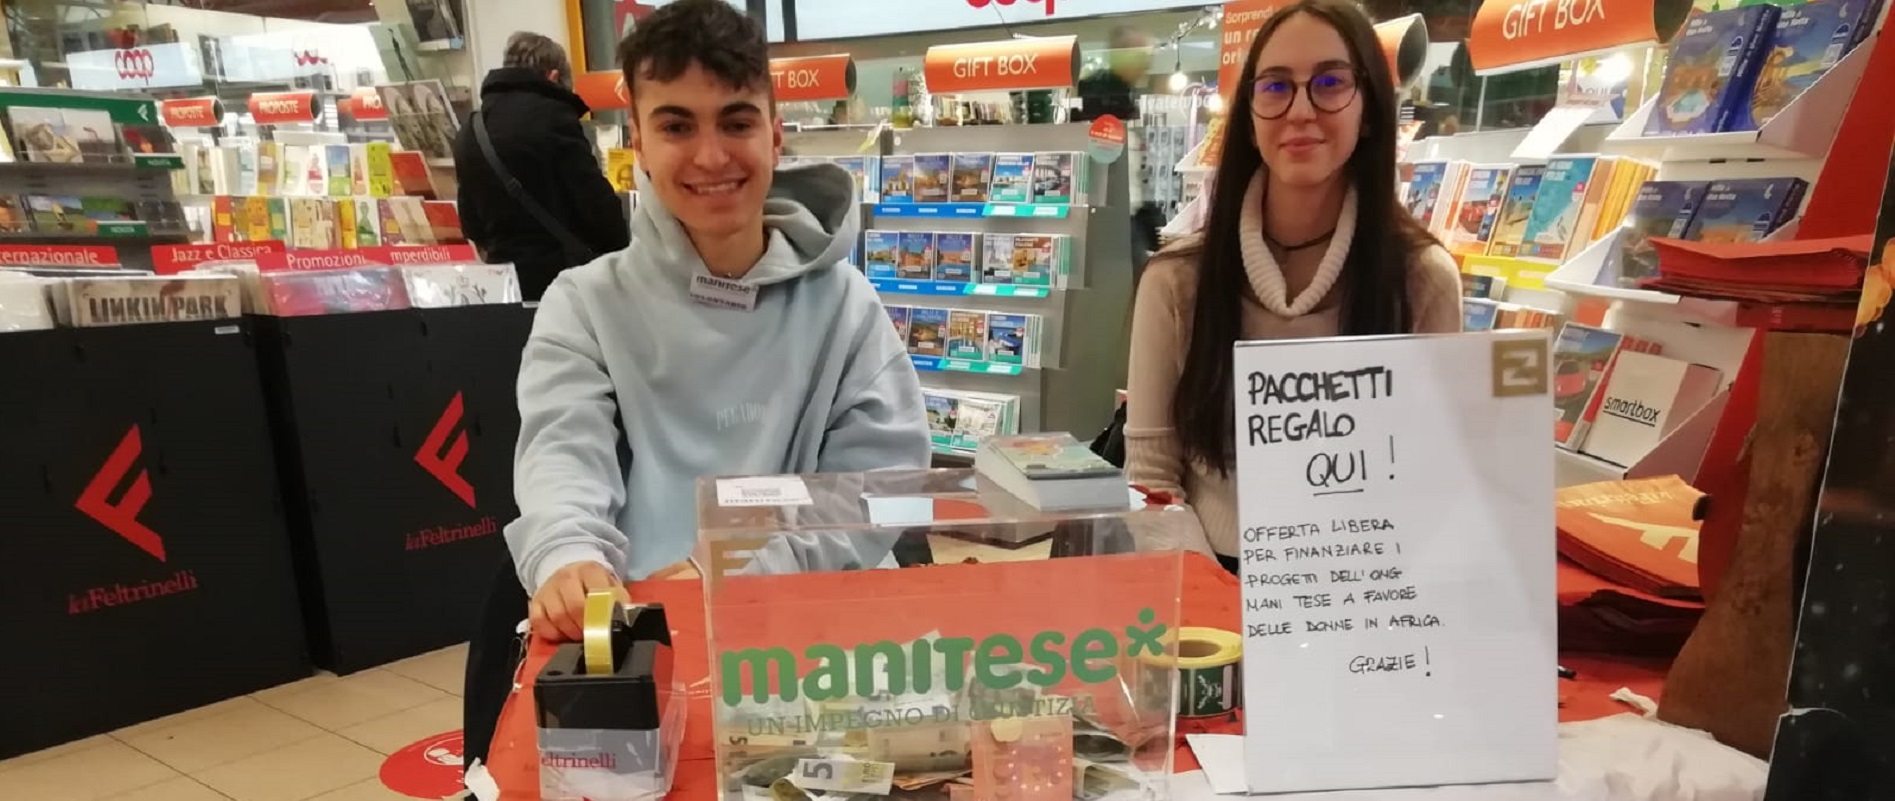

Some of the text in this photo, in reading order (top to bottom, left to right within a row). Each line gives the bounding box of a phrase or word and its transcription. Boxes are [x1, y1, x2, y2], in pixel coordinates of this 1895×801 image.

[1502, 0, 1605, 39] GIFT BOX
[1224, 32, 1241, 44] un
[787, 69, 819, 88] BOX
[953, 54, 1038, 79] GIFT BOX
[259, 101, 299, 115] PROPOSTE
[171, 244, 272, 263] Jazz e Classica
[286, 251, 367, 270] Promozioni
[89, 295, 228, 322] LINKIN PARK
[1248, 365, 1393, 406] PACCHETTI
[1604, 397, 1661, 422] smartbox
[1248, 409, 1356, 446] REGALO
[1306, 449, 1367, 488] QUI
[1243, 519, 1395, 543] OFFERTA LIBERA
[1243, 548, 1277, 565] PER
[1284, 541, 1384, 562] FINANZIARE
[1245, 573, 1319, 588] PROGETTI
[1246, 586, 1418, 612] MANI TESE A FAVORE
[1248, 622, 1293, 638] DELLE
[1306, 618, 1354, 632] DONNE
[1365, 617, 1378, 630] IN
[747, 716, 784, 736] UN
[792, 706, 923, 732] IMPEGNO
[934, 704, 960, 723] DI
[802, 762, 833, 780] 5
